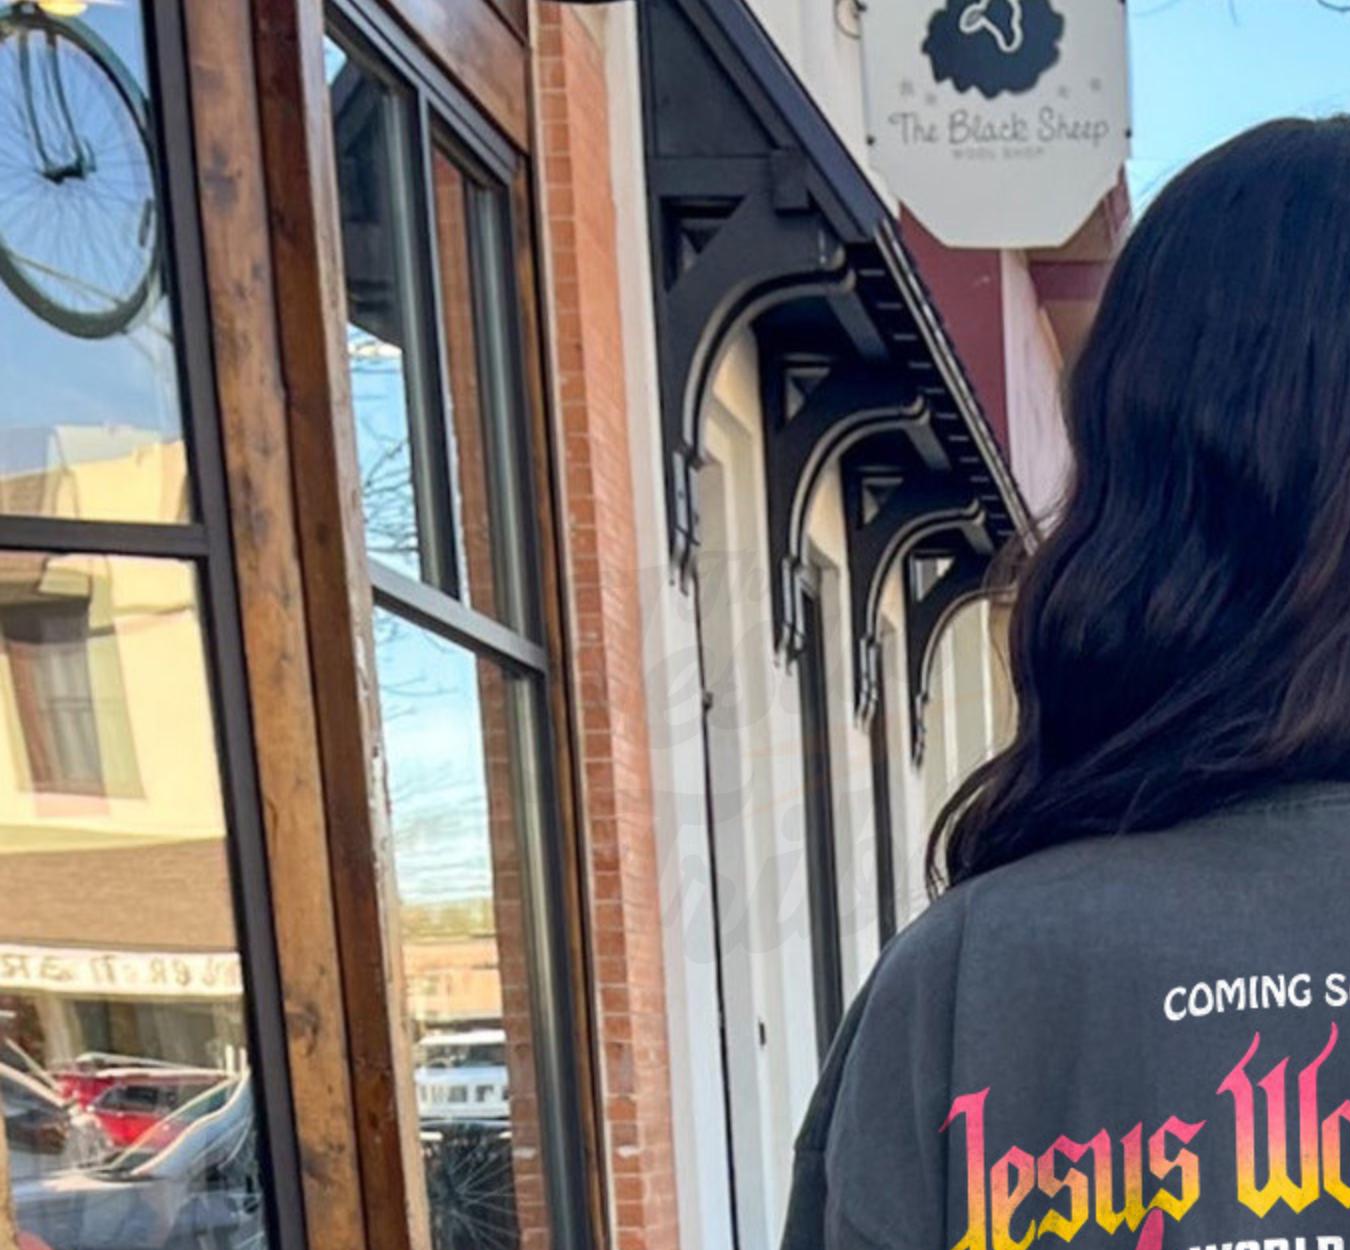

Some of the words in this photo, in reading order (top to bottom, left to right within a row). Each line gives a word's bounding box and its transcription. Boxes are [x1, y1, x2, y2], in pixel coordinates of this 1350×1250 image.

[889, 113, 937, 144] The
[948, 109, 1028, 145] Black
[1038, 106, 1109, 147] Sheep
[1164, 974, 1311, 1021] COMING
